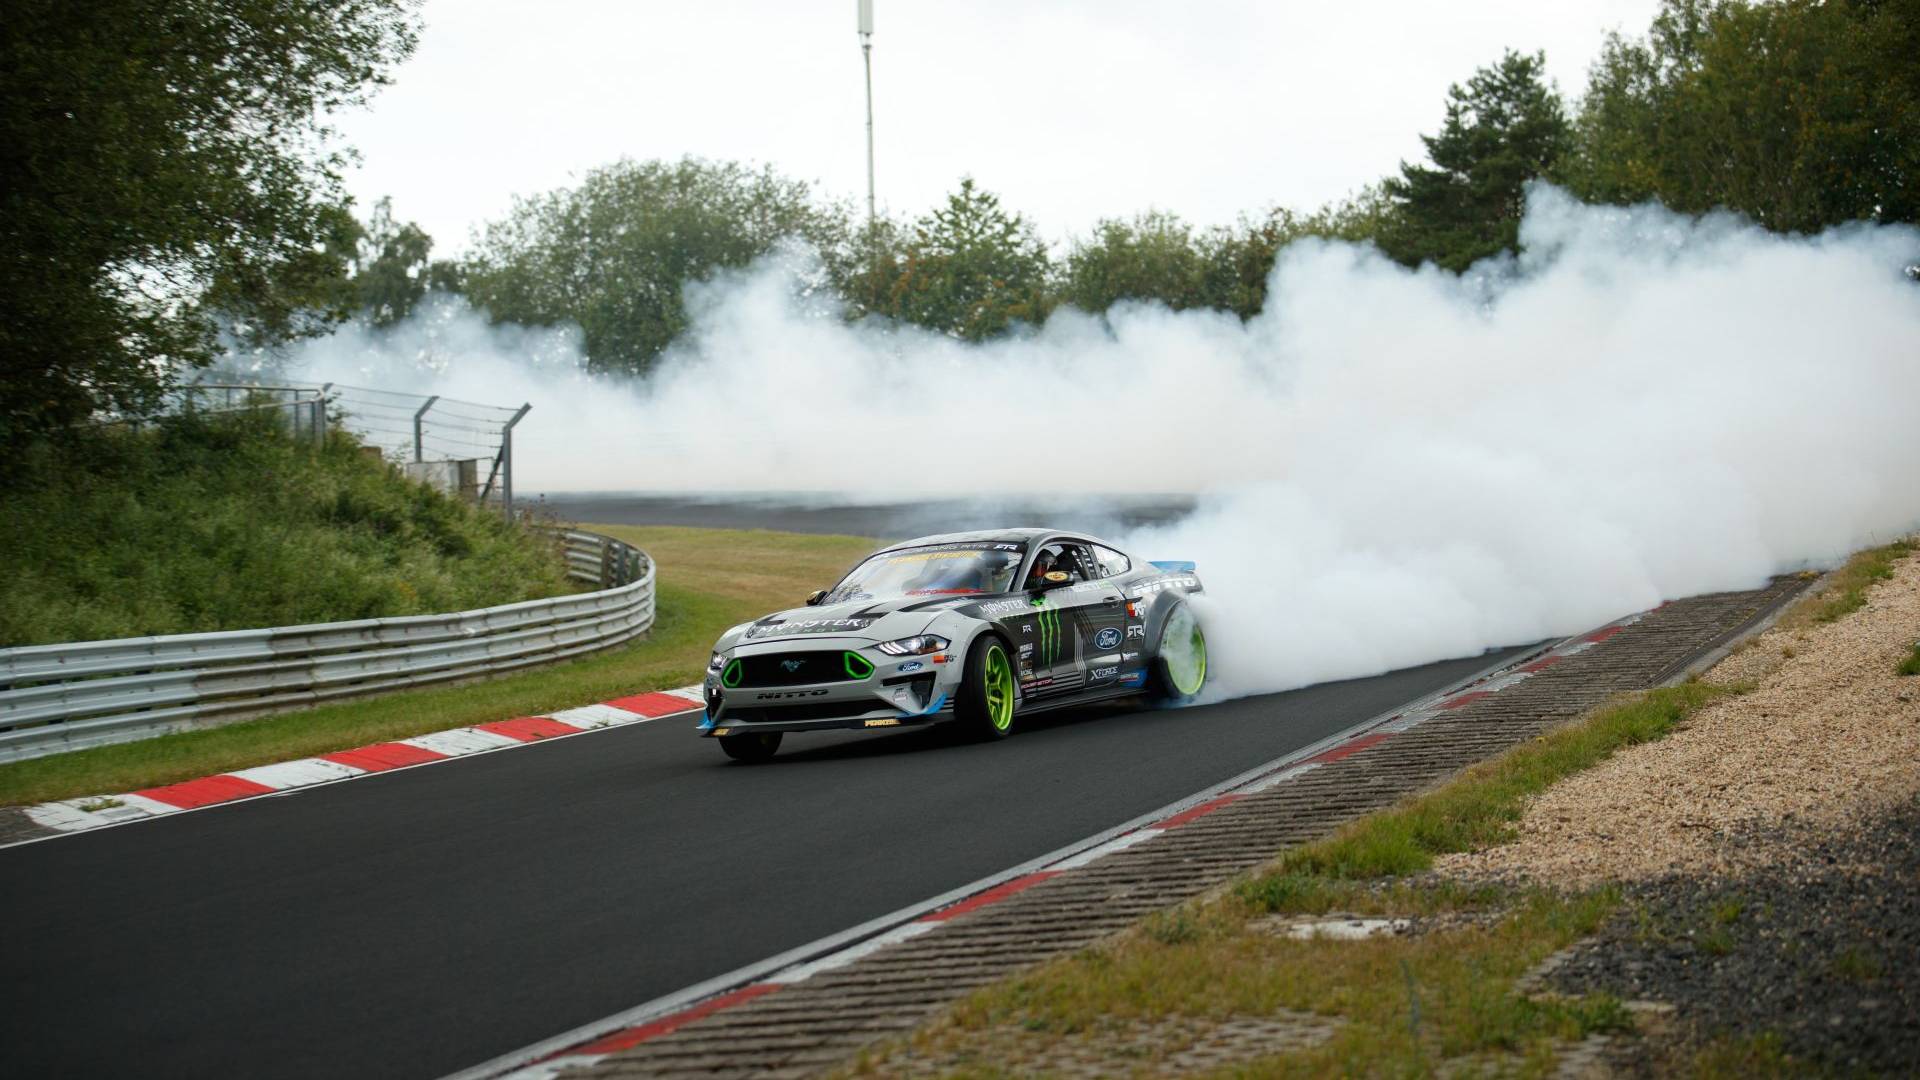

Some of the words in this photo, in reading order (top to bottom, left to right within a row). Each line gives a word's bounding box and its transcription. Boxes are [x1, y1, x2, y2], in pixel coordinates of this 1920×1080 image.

[979, 599, 1028, 615] MONSTER
[757, 618, 861, 634] MONSTER
[1127, 624, 1145, 638] RTR
[1100, 630, 1118, 646] Ford
[902, 662, 920, 672] Ford
[757, 689, 829, 700] NITTO
